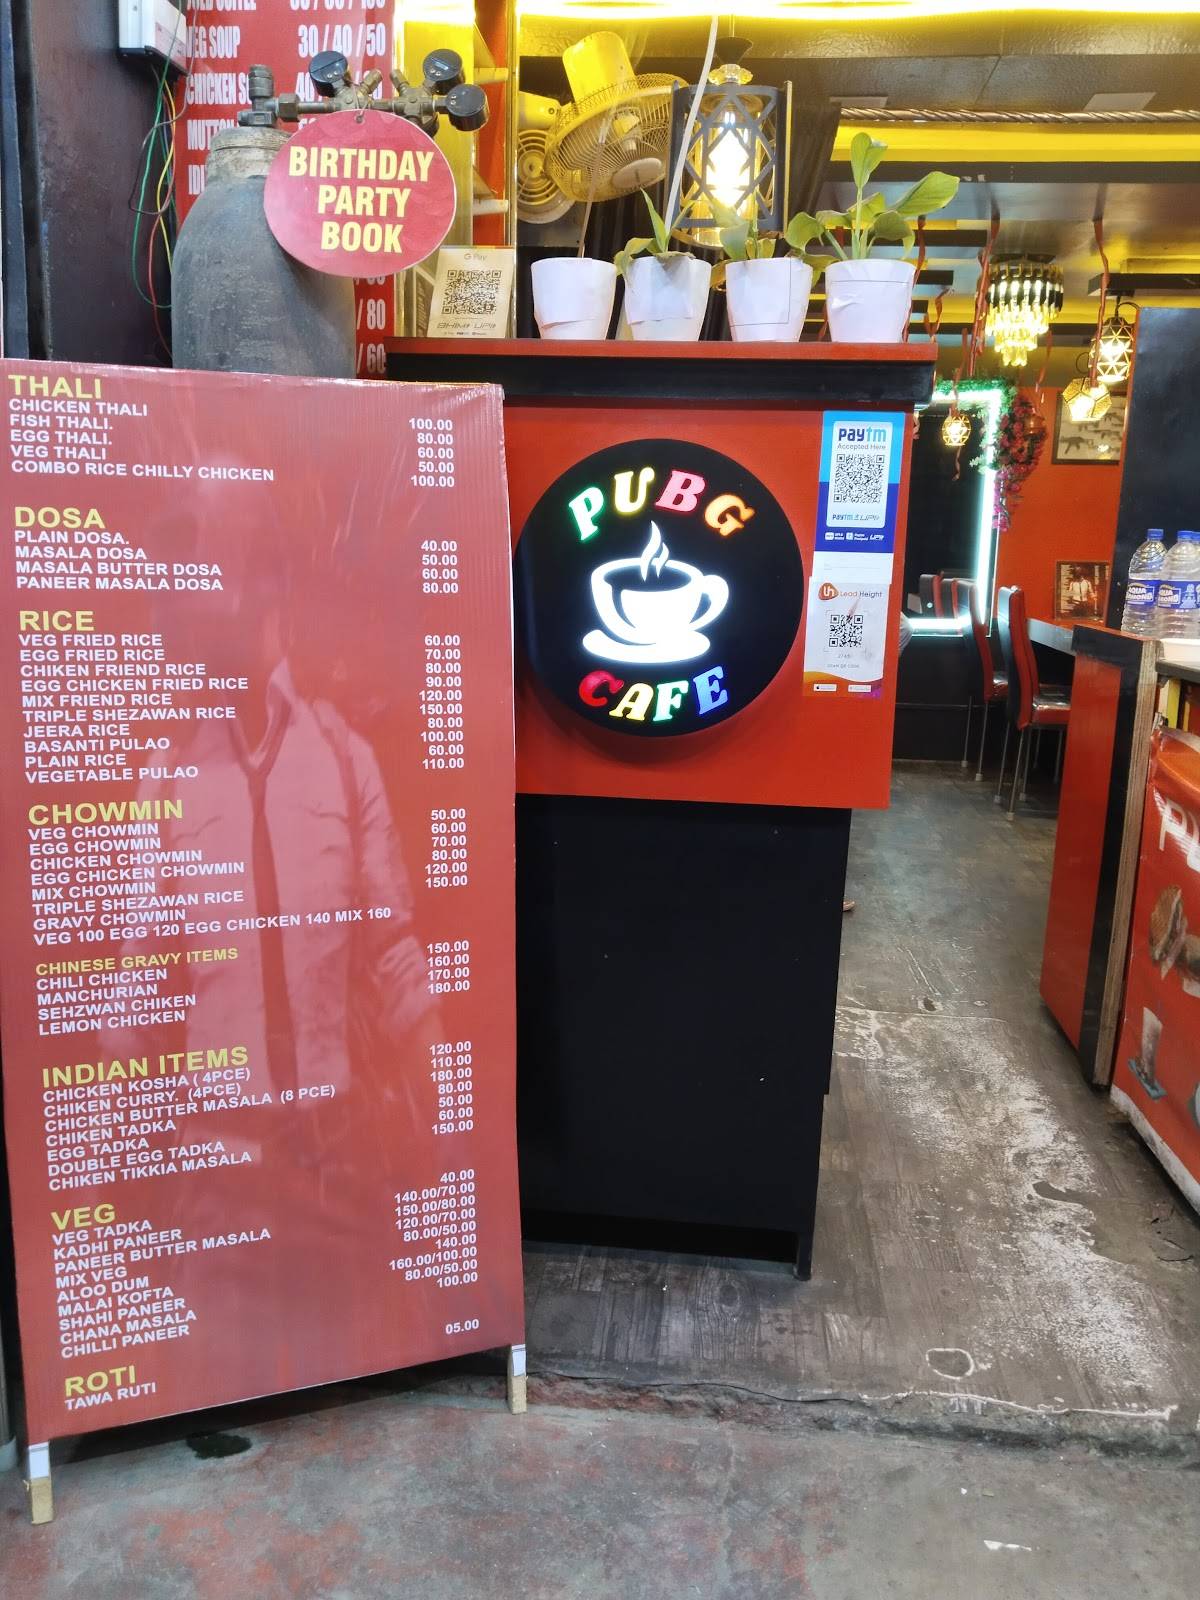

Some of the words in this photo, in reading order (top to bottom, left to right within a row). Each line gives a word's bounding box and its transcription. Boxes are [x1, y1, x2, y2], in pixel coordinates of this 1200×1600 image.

[209, 26, 241, 58] SOUP
[187, 73, 236, 105] CHICKEN
[289, 146, 434, 182] BIRTHDAY
[317, 185, 411, 218] PARTY
[320, 221, 404, 254] BOOK
[8, 374, 102, 400] THALI
[9, 398, 90, 414] CHICKEN
[95, 401, 148, 417] THALI
[10, 413, 50, 427] FISH
[55, 415, 113, 430] THALI.
[408, 417, 453, 431] 100.00
[10, 444, 48, 458] VEG
[53, 446, 106, 460] THALI
[417, 446, 454, 460] 60.00
[11, 459, 80, 475] COMBO
[85, 462, 128, 476] RICE
[132, 463, 194, 479] CHILLY
[197, 466, 274, 481] CHICKEN
[410, 474, 455, 488] 100.00
[568, 466, 755, 541] PUBG
[14, 506, 106, 529] DOSA
[14, 529, 68, 543] PLAIN
[74, 531, 130, 545] DOSA.
[15, 545, 92, 559] MASALA
[96, 547, 148, 560] DOSA
[422, 553, 458, 566] 50.00
[16, 575, 91, 590] PANEER
[95, 577, 170, 590] MASALA
[174, 577, 224, 590] DOSA
[422, 582, 459, 594] 80.00
[19, 610, 95, 632] RICE
[18, 634, 57, 647] VEG
[62, 633, 116, 647] FRIED
[121, 633, 163, 646] RICE
[424, 648, 461, 660] 70.00
[20, 664, 89, 677] CHIKEN
[95, 663, 160, 676] FRIEND
[165, 663, 207, 675] RICE
[21, 679, 61, 693] EGG
[66, 678, 146, 692] CHICKEN
[152, 677, 204, 691] FRIED
[208, 677, 249, 690] RICE
[425, 675, 462, 688] 90.00
[578, 665, 729, 723] CAFE
[22, 709, 87, 723] TRIPLE
[92, 707, 191, 721] SHEZAWAN
[195, 706, 236, 719] RICE
[419, 702, 463, 716] 150.00
[24, 739, 104, 754] BASANTI
[109, 737, 170, 751] PULAO
[420, 730, 464, 743] 100.00
[422, 757, 465, 770] 110.00
[24, 767, 134, 784] VEGETABLE
[139, 765, 199, 780] PULAO
[28, 799, 183, 826] CHOWMIN
[27, 826, 66, 841] VEG
[71, 822, 158, 839] CHOWMIN
[431, 821, 467, 834] 60.00
[30, 854, 111, 871] CHICKEN
[117, 849, 202, 866] CHOWMIN
[431, 848, 468, 861] 80.00
[31, 871, 70, 886] EGG
[75, 866, 155, 883] CHICKEN
[160, 861, 244, 878] CHOWMIN
[425, 874, 468, 889] 150.00
[33, 931, 72, 946] VEG
[76, 928, 105, 943] 100
[109, 925, 148, 940] EGG
[153, 923, 180, 937] 120
[184, 920, 221, 935] EGG
[226, 914, 301, 931] CHICKEN
[305, 912, 331, 925] 140
[335, 909, 363, 923] MIX
[367, 907, 392, 920] 160
[35, 957, 116, 976] CHINESE
[121, 952, 182, 969] GRAVY
[186, 947, 238, 964] ITEMS
[427, 953, 470, 968] 160.00
[36, 975, 83, 991] CHILI
[88, 967, 167, 986] CHICKEN
[427, 979, 471, 995] 180.00
[37, 983, 158, 1006] MANCHURIAN
[37, 1001, 126, 1021] SEHZWAN
[131, 994, 196, 1012] CHIKEN
[38, 1018, 102, 1036] LEMON
[107, 1009, 185, 1029] CHICKEN
[42, 1057, 148, 1089] INDIAN
[159, 1046, 248, 1075] ITEMS
[430, 1053, 472, 1069] 110.00
[438, 1080, 473, 1095] 80.00
[43, 1098, 111, 1118] CHIKEN
[44, 1111, 124, 1133] CHICKEN
[130, 1102, 199, 1122] BUTTER
[203, 1093, 273, 1112] MASALA
[438, 1106, 474, 1121] 60.00
[45, 1127, 113, 1147] CHIKEN
[118, 1119, 177, 1137] TADKA
[439, 1168, 475, 1184] 40.00
[394, 1194, 476, 1217] 150.00/80.00
[50, 1203, 116, 1231] VEG
[52, 1229, 89, 1246] VEG
[94, 1220, 153, 1239] TADKA
[403, 1220, 477, 1242] 80.00/50.00
[54, 1252, 125, 1275] PANEER
[130, 1240, 198, 1262] BUTTER
[202, 1229, 272, 1250] MASALA
[388, 1245, 478, 1271] 160.00/100.00
[436, 1271, 478, 1289] 100.00
[58, 1296, 112, 1317] MALAI
[117, 1287, 174, 1306] KOFTA
[61, 1337, 117, 1359] CHILLI
[121, 1324, 190, 1348] PANEER
[64, 1365, 136, 1398] ROTI
[64, 1391, 113, 1411] TAWA
[117, 1382, 156, 1401] RUTI
